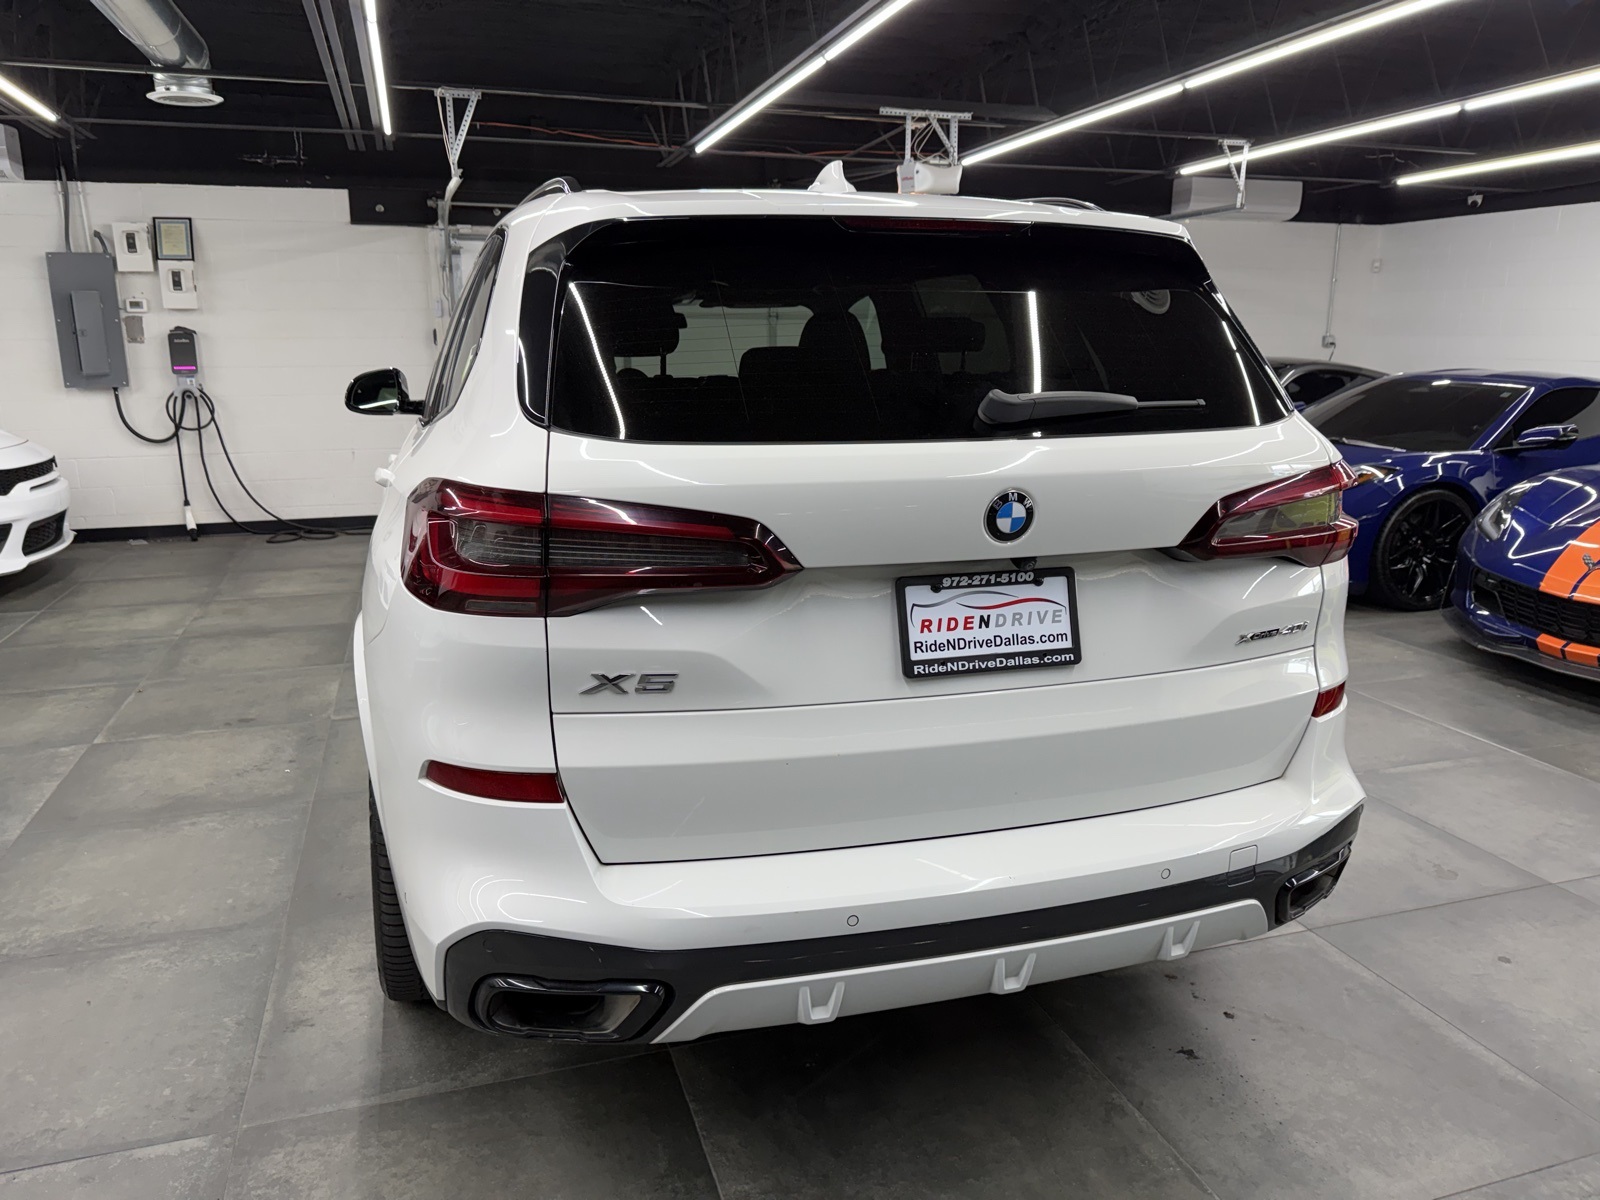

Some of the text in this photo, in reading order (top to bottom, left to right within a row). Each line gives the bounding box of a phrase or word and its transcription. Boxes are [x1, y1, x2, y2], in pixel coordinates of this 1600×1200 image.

[992, 492, 1032, 510] BMW
[941, 571, 1035, 588] 972-271-5100
[919, 608, 1063, 634] RIDENDRIVE
[913, 632, 1068, 654] RideNDriveDallas.com
[913, 652, 1075, 675] RideNDriveDallas.com
[579, 673, 680, 695] X5
